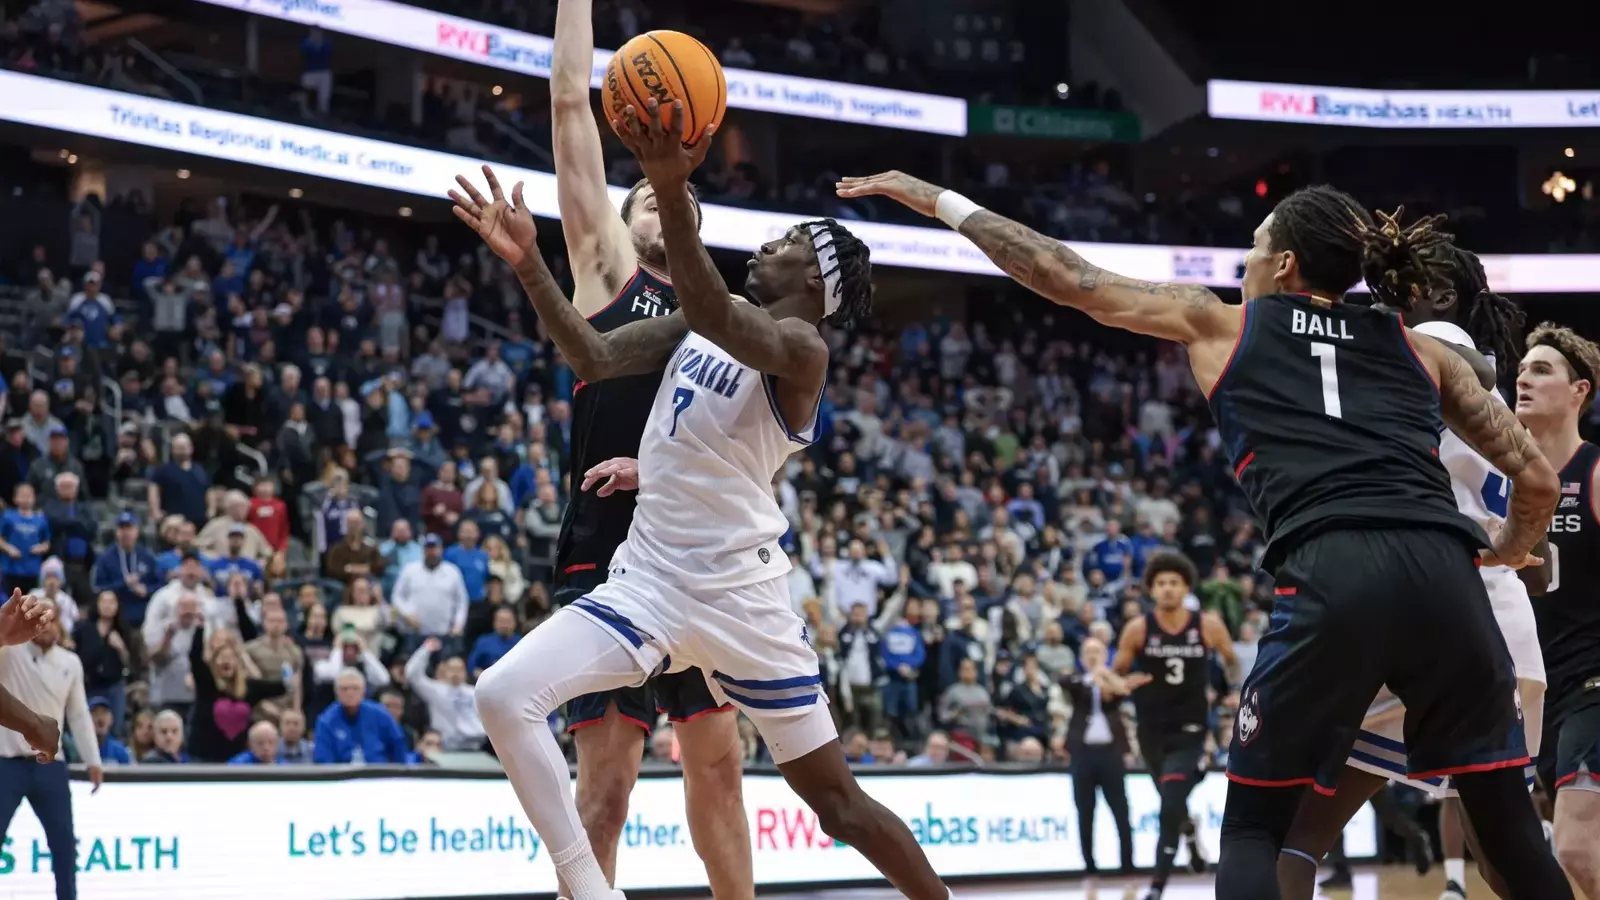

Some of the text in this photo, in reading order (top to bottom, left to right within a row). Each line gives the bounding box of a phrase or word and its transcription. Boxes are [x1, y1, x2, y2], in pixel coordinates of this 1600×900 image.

[437, 20, 553, 69] RWJBarna
[1259, 89, 1511, 120] RWJBarnabas HEALTH
[109, 104, 415, 177] Trinitas Regional Medical Center
[1291, 308, 1354, 339] BALL
[1310, 341, 1342, 419] 1
[668, 386, 695, 437] 7
[1164, 657, 1185, 685] 3
[288, 813, 686, 862] Let's be healthy ther.
[988, 815, 1069, 843] HEALTH
[31, 836, 179, 874] HALTH
